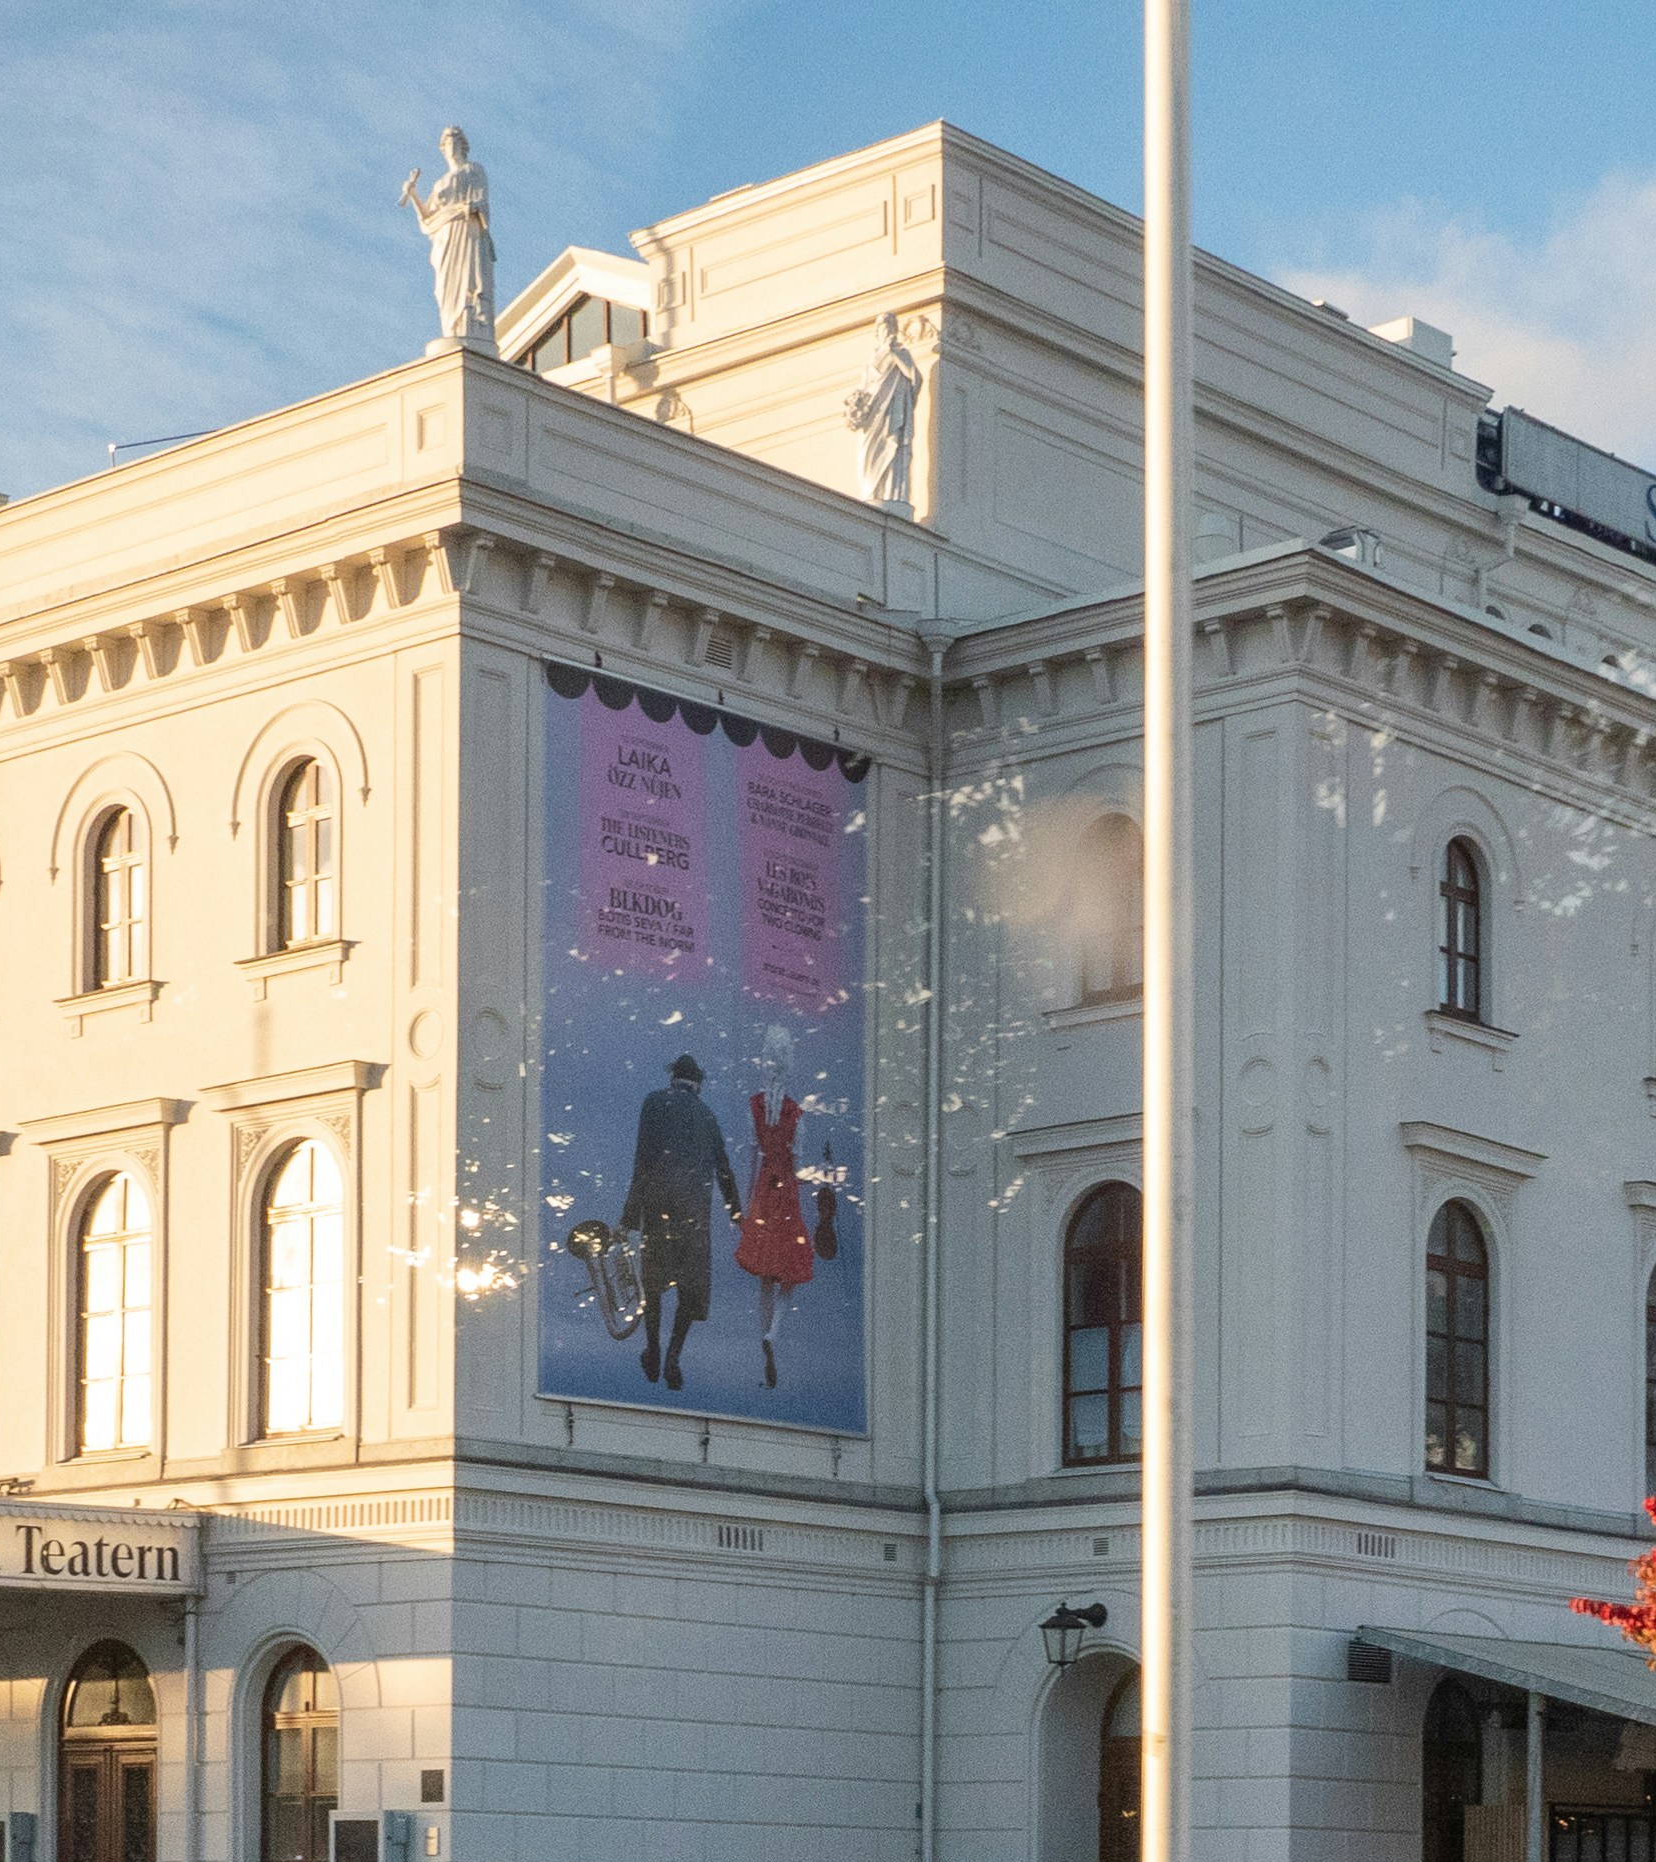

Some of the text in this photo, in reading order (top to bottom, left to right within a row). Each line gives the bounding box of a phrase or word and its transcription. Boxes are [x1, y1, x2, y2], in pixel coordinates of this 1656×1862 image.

[618, 746, 672, 778] LAIKA
[600, 816, 624, 835] THE
[627, 823, 691, 851] LISTENERS
[609, 887, 683, 922] BLKDOG
[635, 930, 656, 947] THE
[16, 1525, 181, 1583] Teatern
